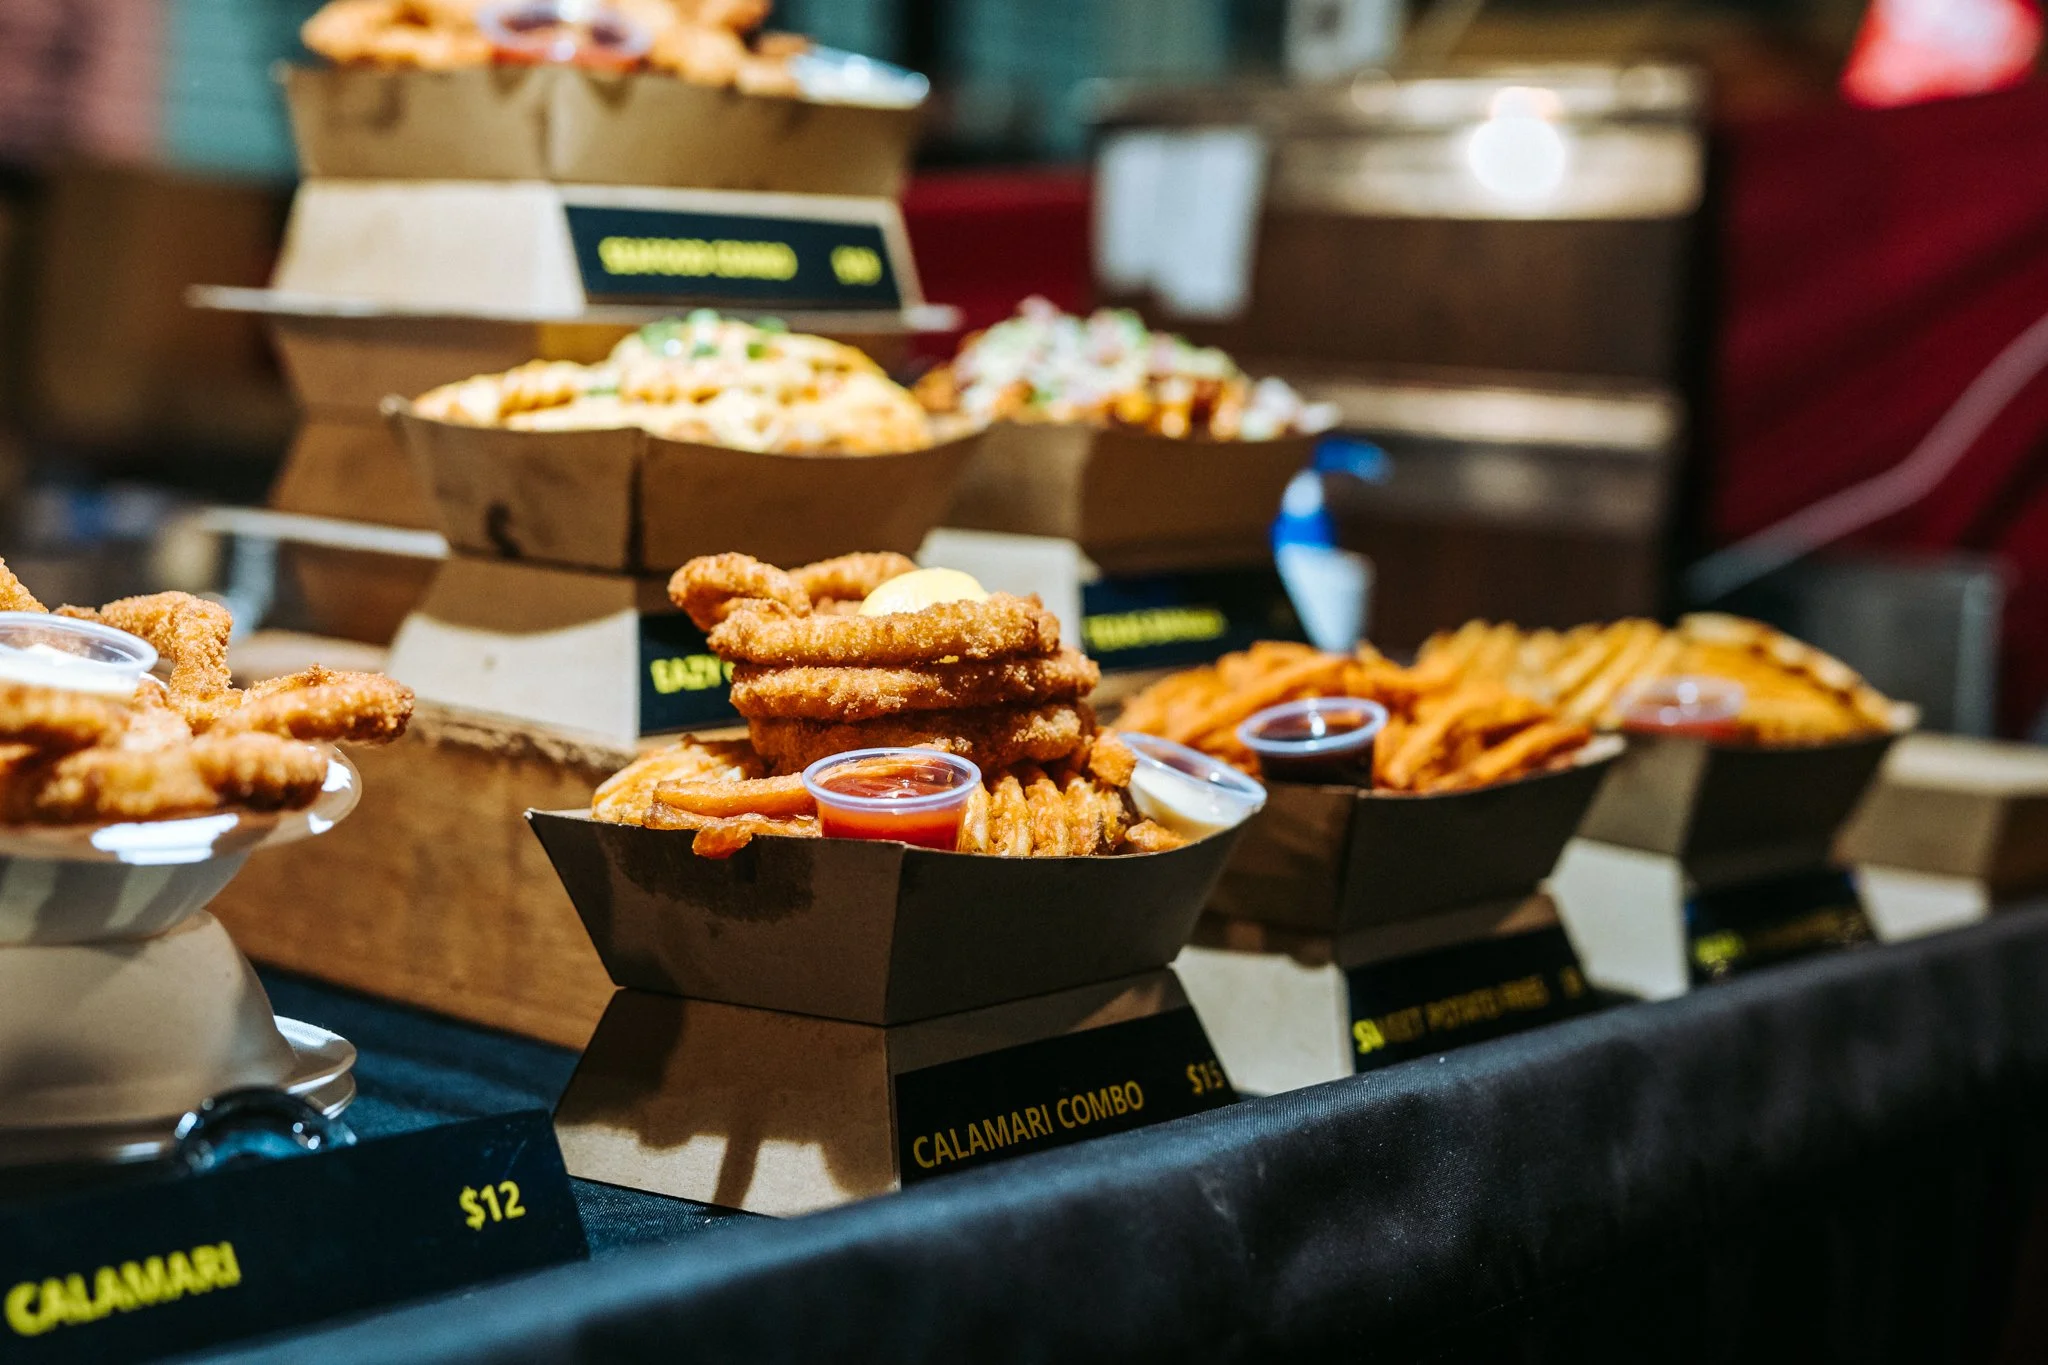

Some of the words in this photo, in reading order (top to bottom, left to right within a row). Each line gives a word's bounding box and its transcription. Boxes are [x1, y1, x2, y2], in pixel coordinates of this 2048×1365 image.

[913, 1104, 1053, 1169] CALAMARI
[1056, 1080, 1145, 1130] COMBO
[459, 1180, 526, 1231] $12
[4, 1241, 241, 1337] CALAMARI
